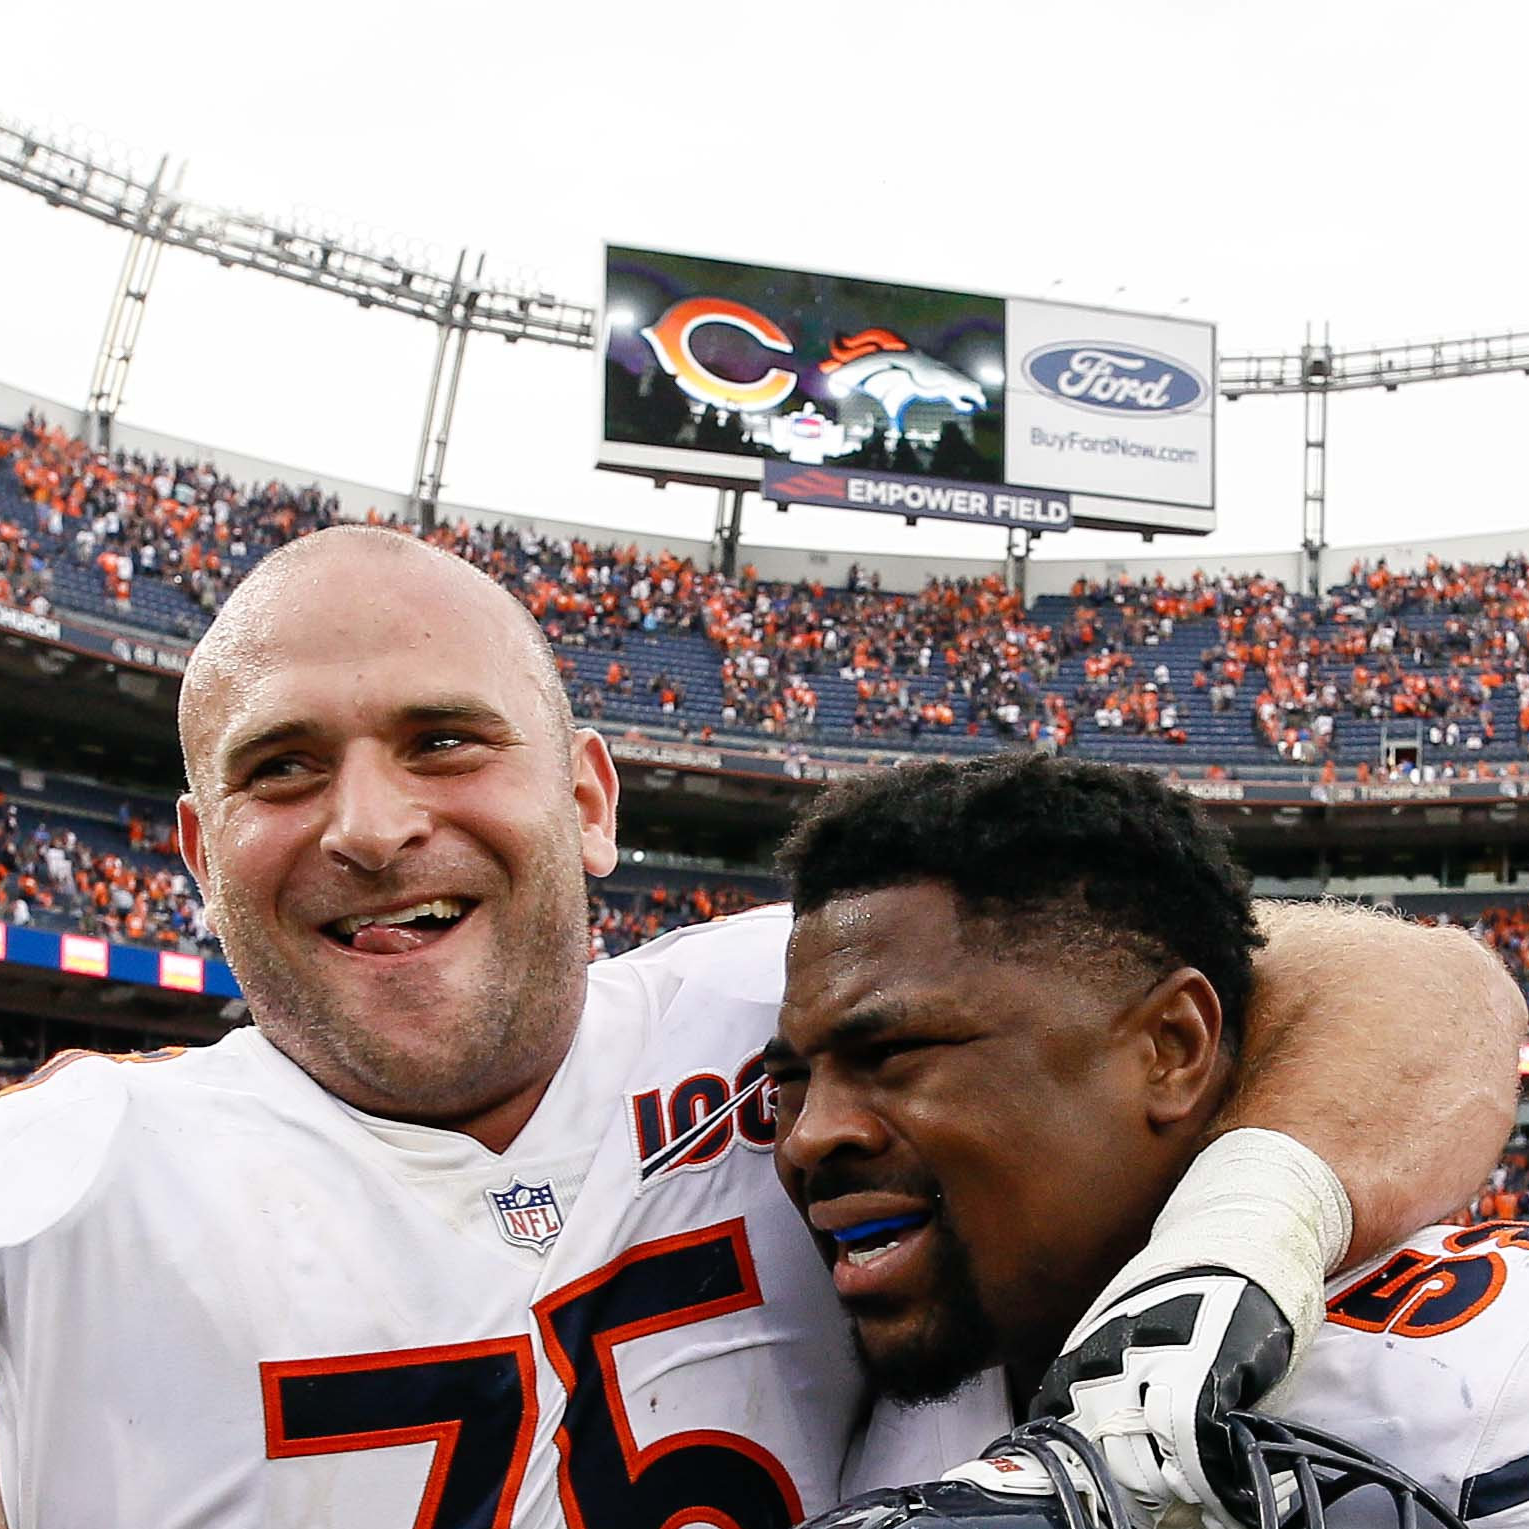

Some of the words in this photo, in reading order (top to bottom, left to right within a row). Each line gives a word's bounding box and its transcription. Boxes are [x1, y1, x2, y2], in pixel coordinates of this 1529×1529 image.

[1058, 351, 1173, 408] Ford
[1030, 427, 1199, 464] BuyFordNow.com
[847, 477, 988, 517] EMPOWER
[993, 494, 1069, 524] FIELD
[1360, 782, 1451, 801] THOMPSON
[504, 1207, 560, 1239] NFL
